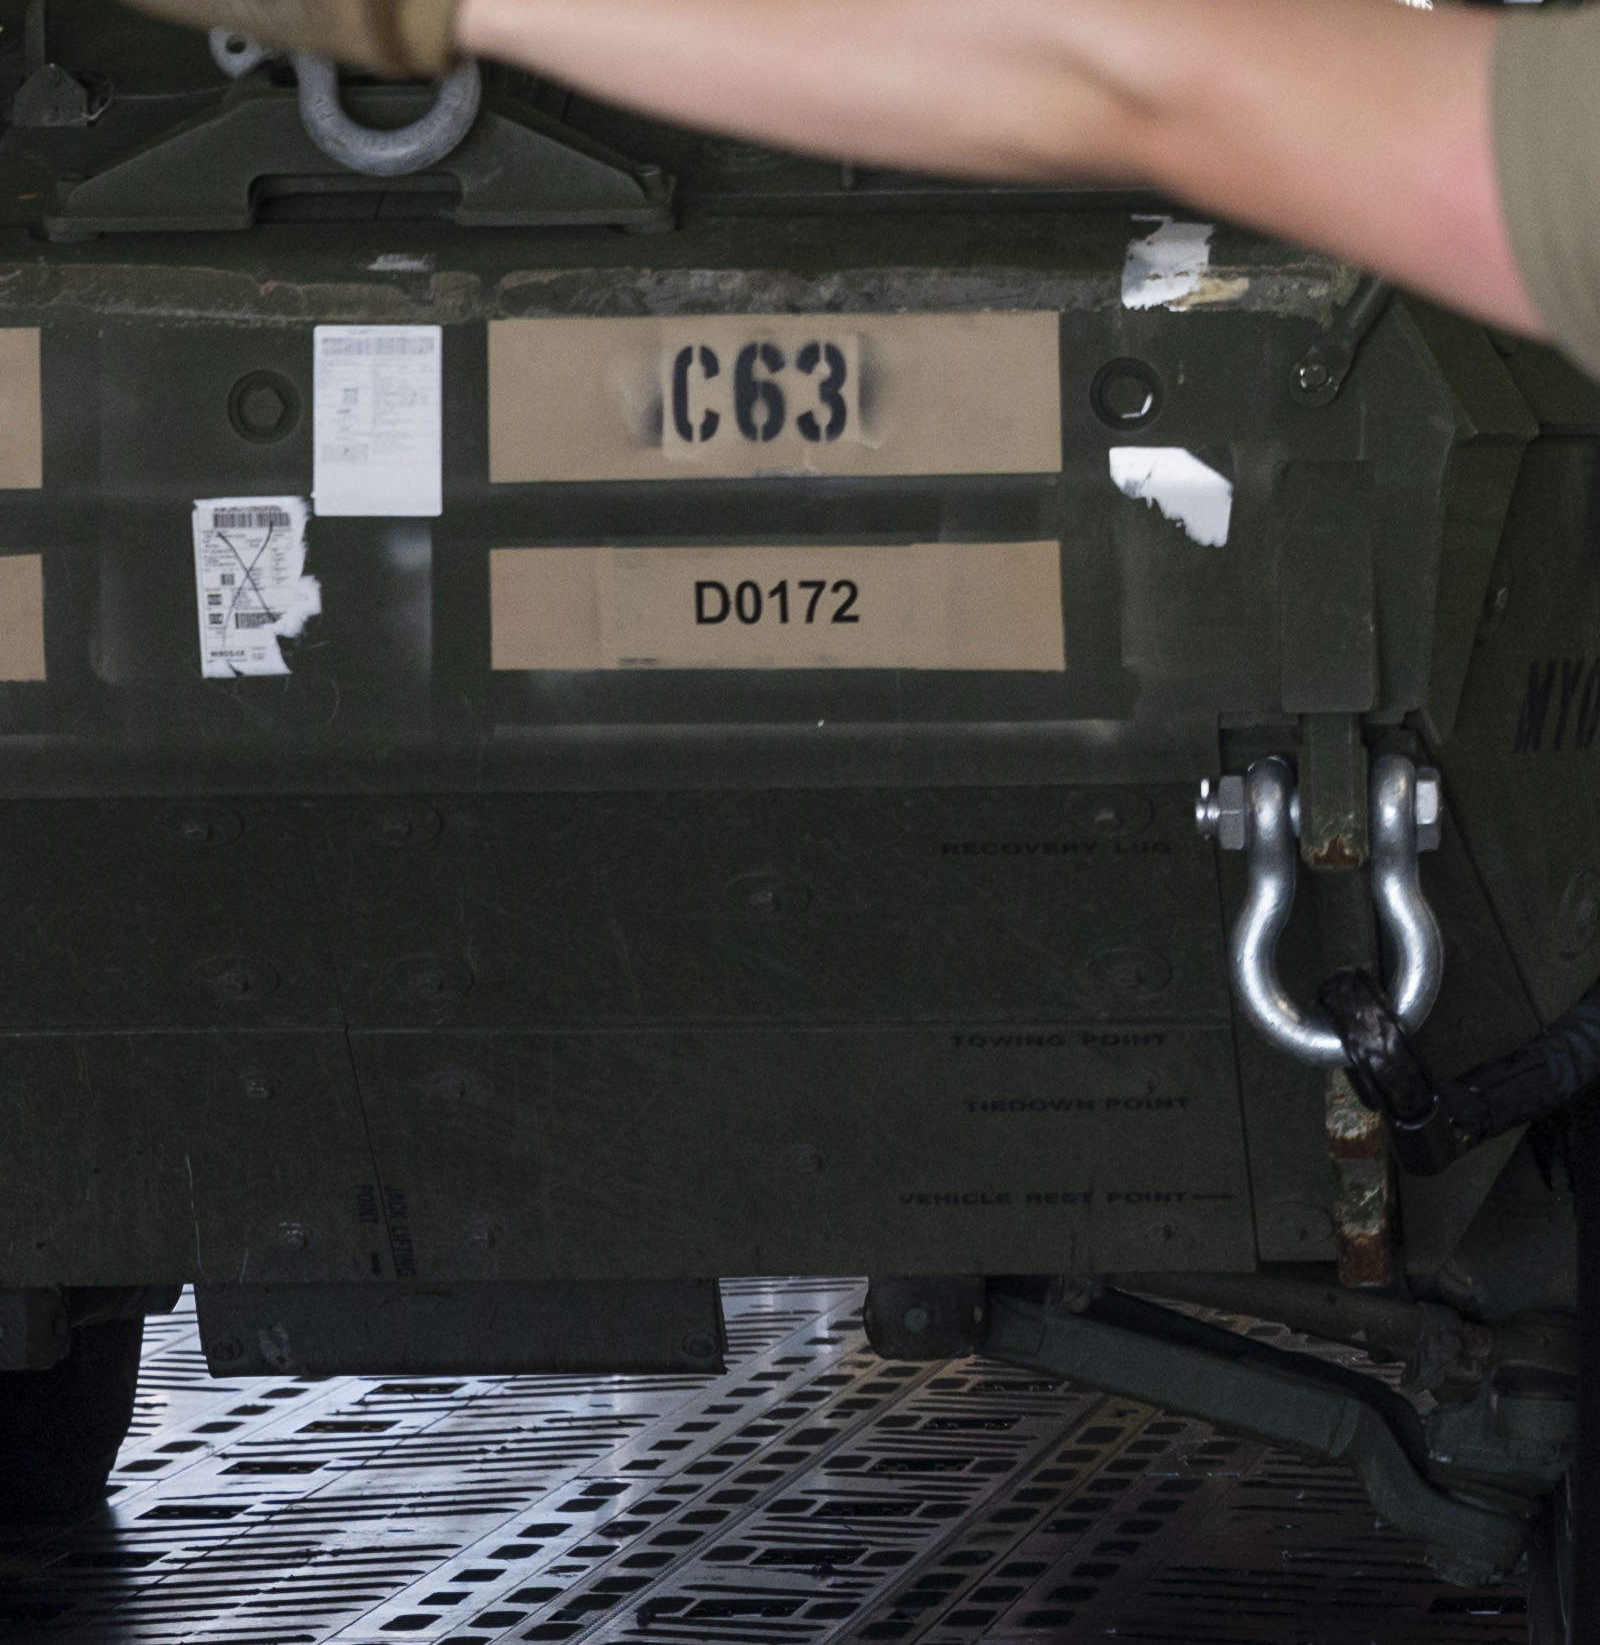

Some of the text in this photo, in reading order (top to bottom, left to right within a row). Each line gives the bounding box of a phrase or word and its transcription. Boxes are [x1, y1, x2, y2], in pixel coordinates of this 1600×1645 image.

[672, 341, 847, 443] C63
[694, 579, 860, 625] D0172
[941, 840, 1173, 856] RECOVERY LUG
[951, 1032, 1168, 1048] TOWING POINT
[964, 1095, 1191, 1113] TIEDOWN POINT
[900, 1189, 1187, 1205] VEHICLE REST POINT
